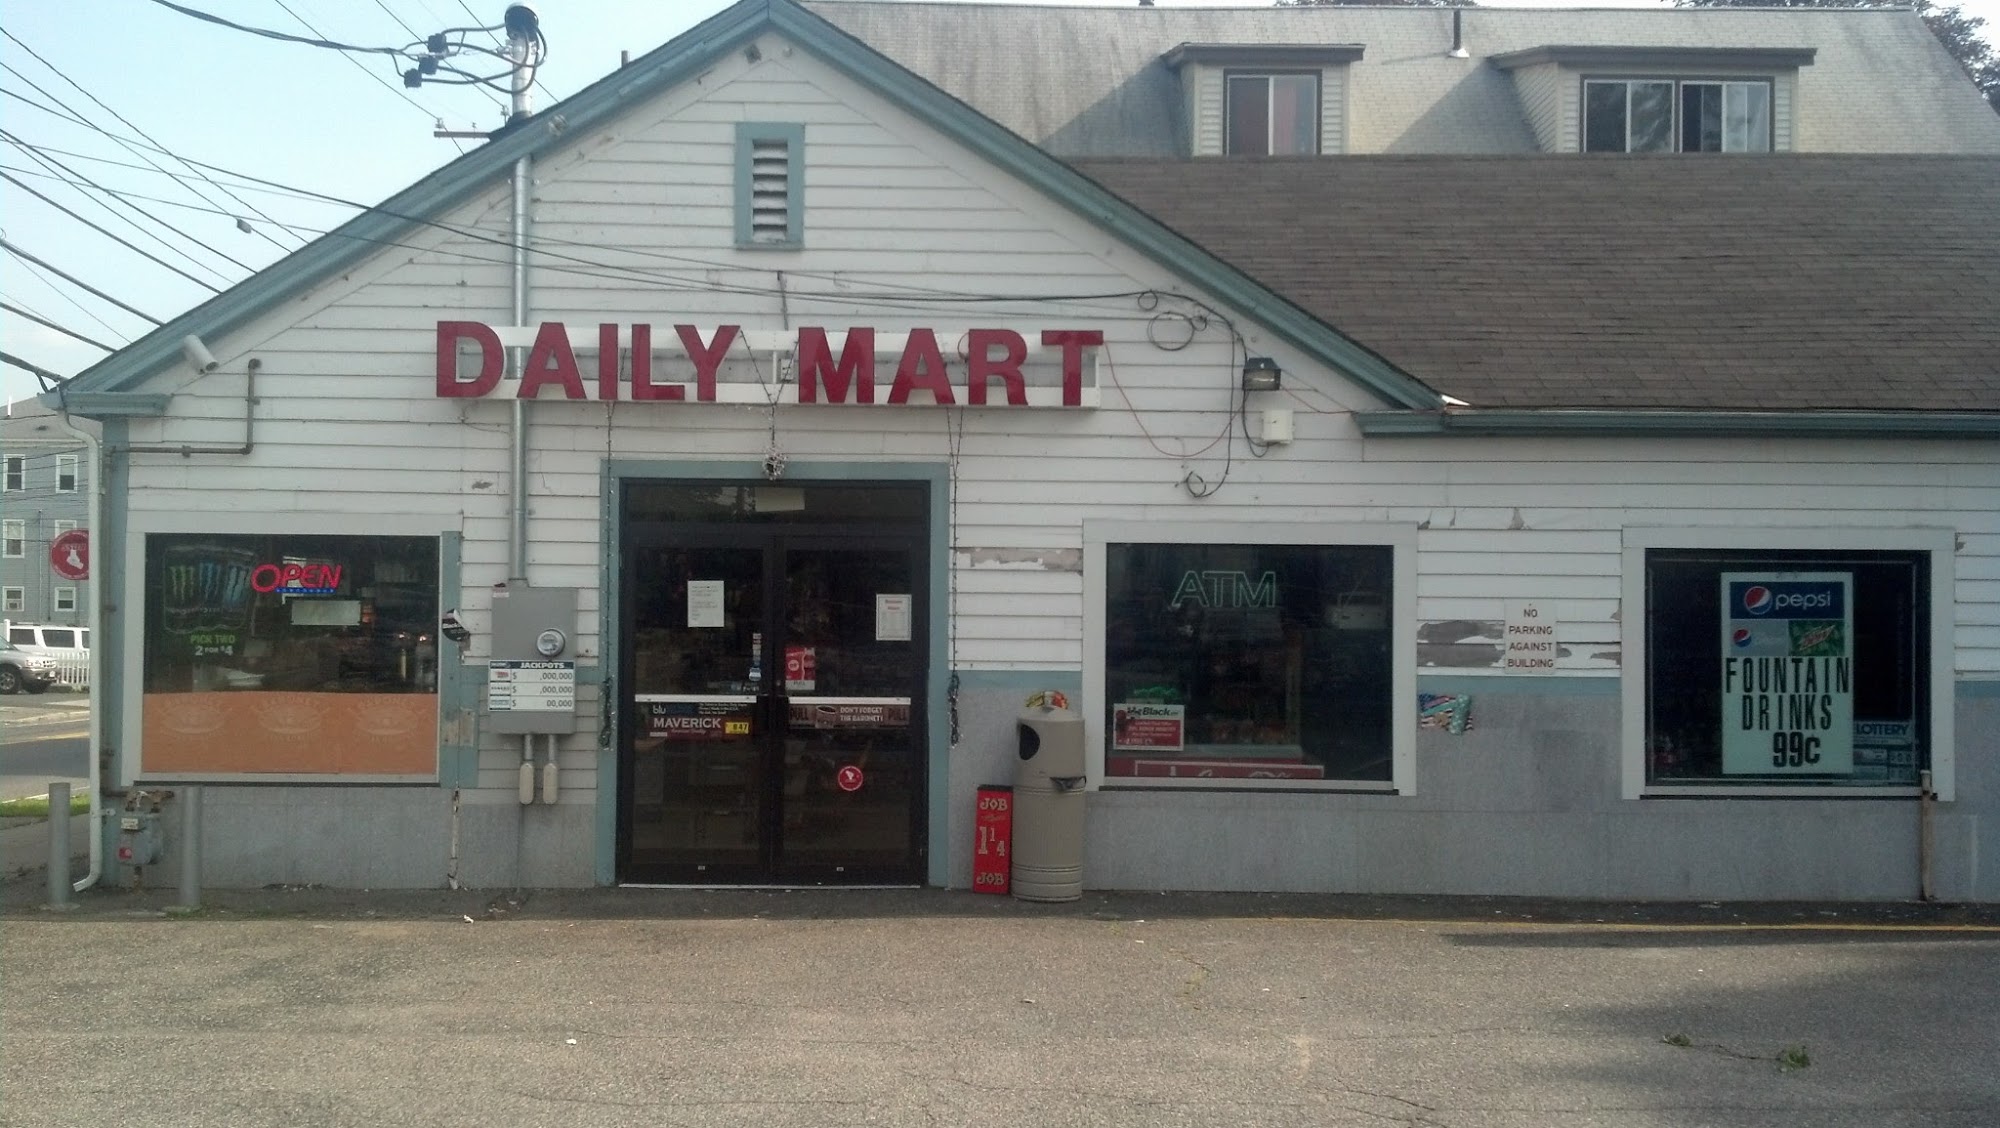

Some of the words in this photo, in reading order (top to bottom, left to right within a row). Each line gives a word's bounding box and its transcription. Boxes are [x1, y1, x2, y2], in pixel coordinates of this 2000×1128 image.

[436, 320, 741, 403] DAILY
[798, 326, 1104, 406] MART
[251, 563, 342, 593] OPEN
[1171, 570, 1276, 608] ATM
[1775, 590, 1831, 611] pepsi
[1523, 608, 1538, 618] NO
[1508, 625, 1553, 635] PARKING
[190, 634, 212, 645] PICK
[215, 634, 236, 645] TWO
[195, 645, 204, 656] 2
[1509, 642, 1553, 651] AGAINST
[1507, 658, 1554, 668] BUILDING
[1725, 656, 1849, 694] FOUNTAIN
[652, 704, 667, 715] blu
[1741, 694, 1833, 731] DRINKS
[653, 717, 722, 729] MAVERICK
[1856, 723, 1909, 736] LOTTERY
[979, 797, 1008, 812] JOB
[976, 872, 1005, 886] JOB
